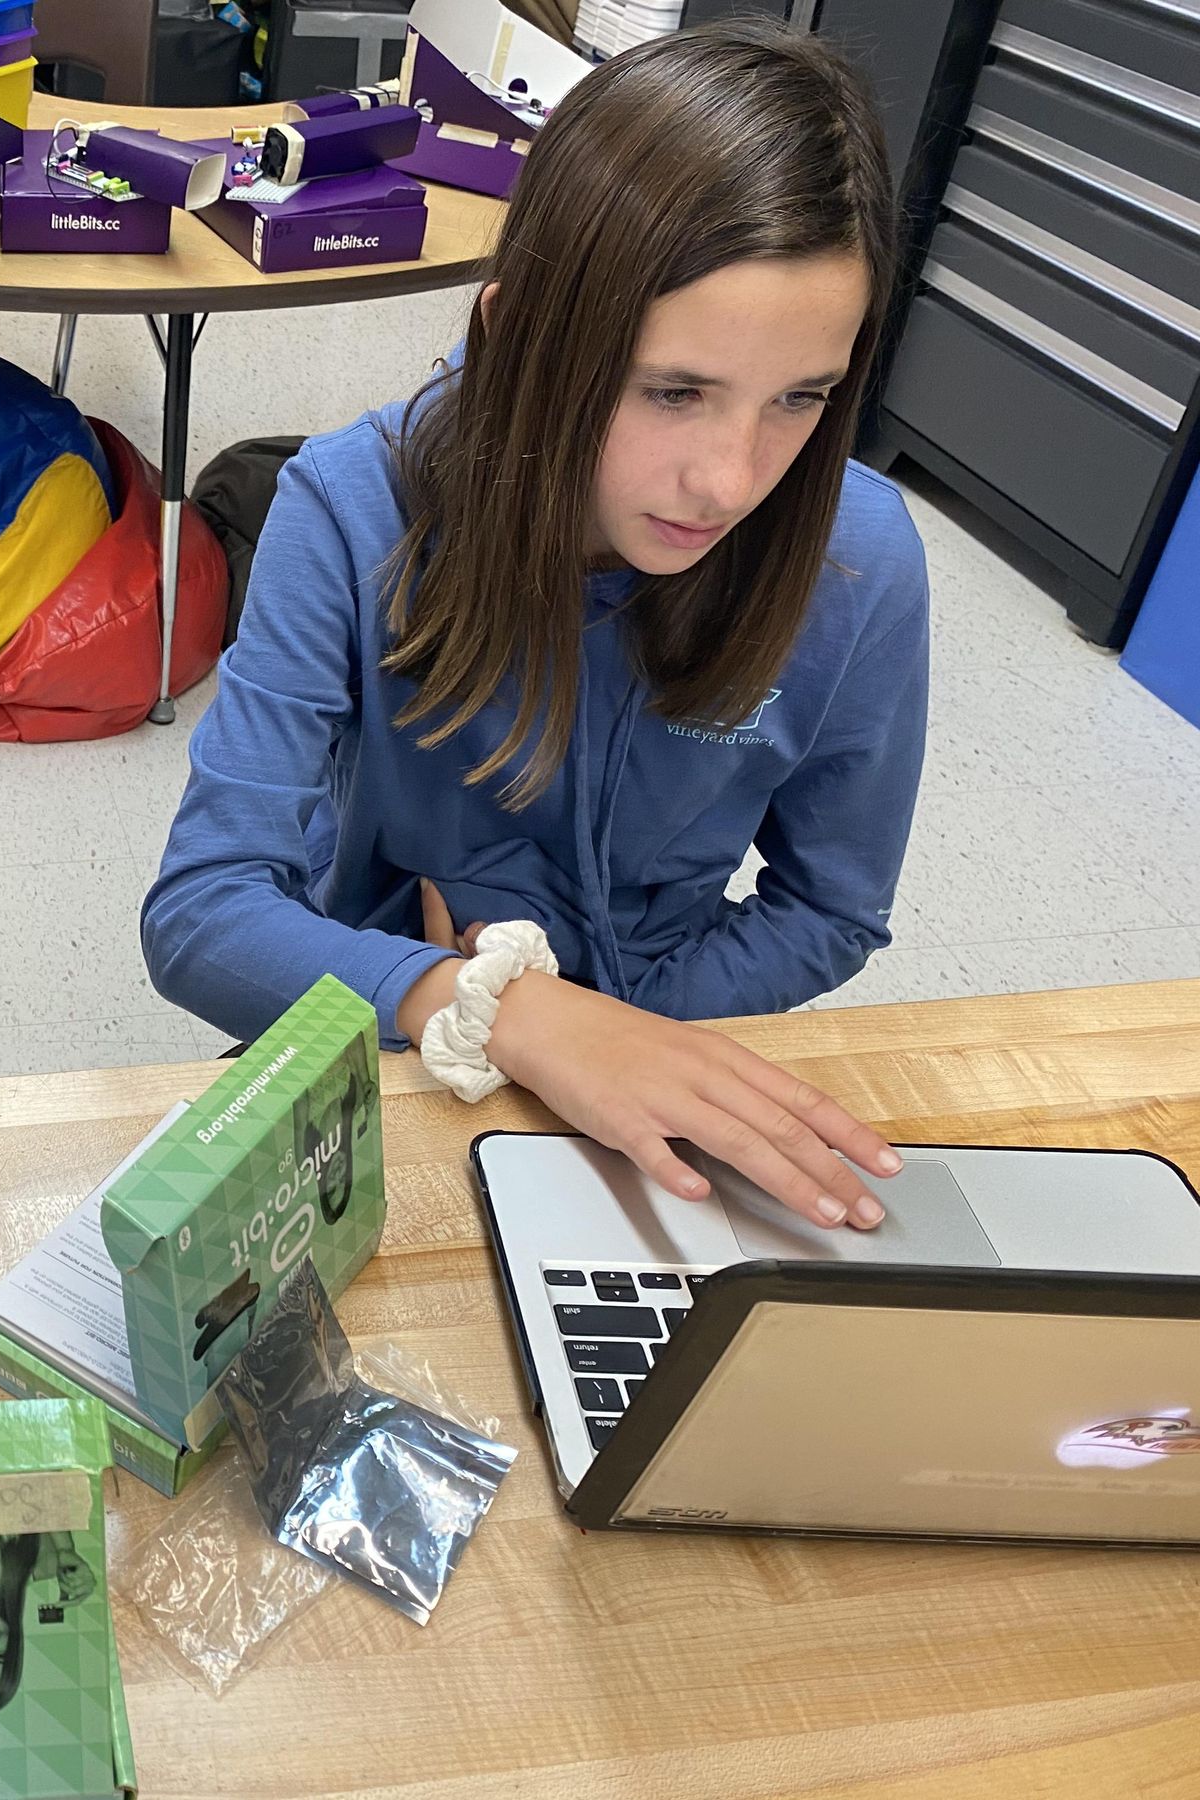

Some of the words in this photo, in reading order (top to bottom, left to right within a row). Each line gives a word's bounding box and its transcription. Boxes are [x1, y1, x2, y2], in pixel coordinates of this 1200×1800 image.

[51, 213, 121, 230] littleBits.cc
[314, 234, 379, 251] littleBits.cc
[666, 724, 737, 744] vineyard
[738, 733, 775, 747] vines
[195, 1045, 298, 1145] www.microbit.org
[278, 1148, 292, 1174] go
[229, 1122, 341, 1267] micro:bit
[562, 1306, 581, 1314] shift
[573, 1343, 599, 1352] return
